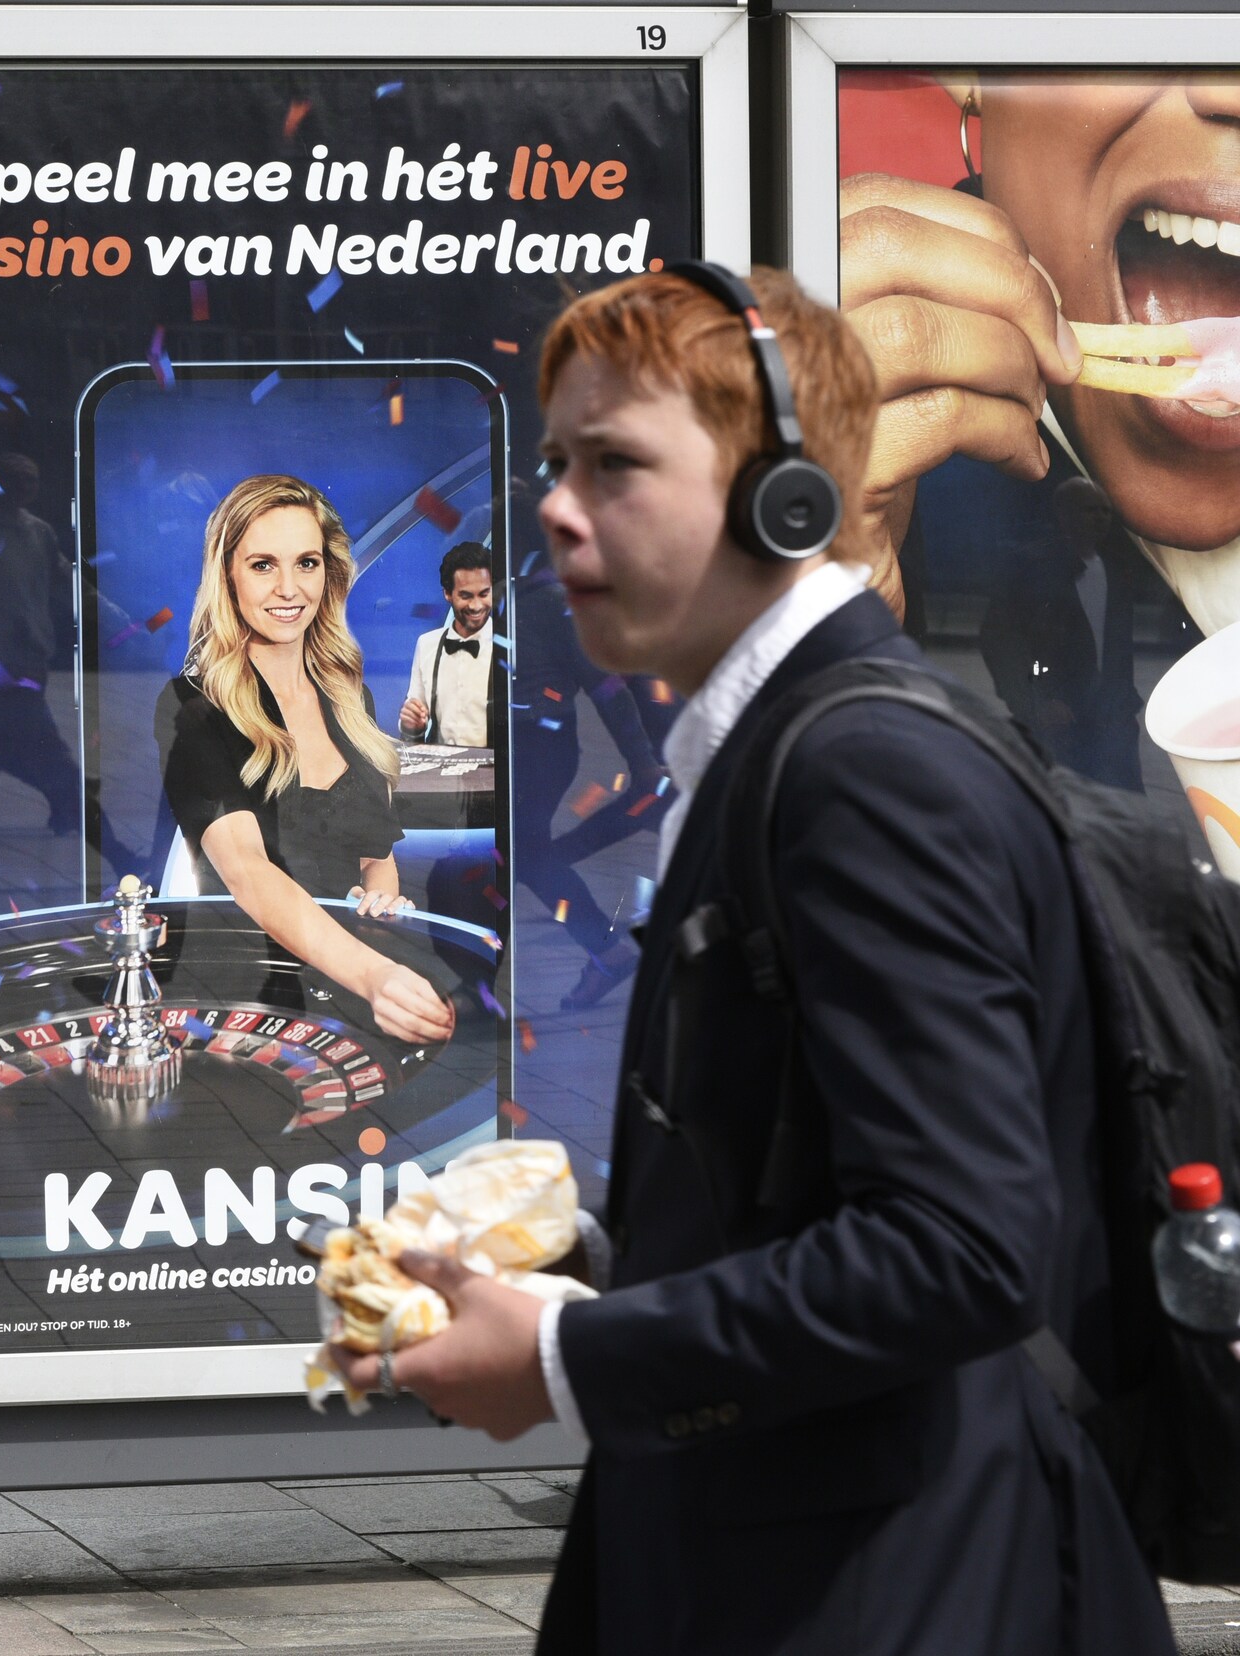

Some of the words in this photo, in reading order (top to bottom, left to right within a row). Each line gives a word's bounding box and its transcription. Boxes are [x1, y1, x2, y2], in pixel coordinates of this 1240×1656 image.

[636, 25, 668, 51] 19
[146, 162, 292, 202] mee
[305, 144, 369, 201] in
[382, 142, 498, 202] hét
[508, 144, 628, 201] live
[144, 237, 273, 277] van
[284, 218, 664, 276] Nederland.
[24, 1028, 54, 1046] 21
[66, 1020, 82, 1038] 2
[165, 1010, 188, 1028] 34
[204, 1010, 219, 1027] 6
[227, 1012, 257, 1030] 27
[256, 1016, 286, 1035] 13
[283, 1022, 313, 1042] 36
[306, 1031, 335, 1051] 11
[46, 1262, 105, 1295] Hét
[108, 1262, 208, 1292] online
[211, 1259, 316, 1289] casino
[13, 1322, 38, 1332] JOU?
[40, 1322, 68, 1331] STOP
[70, 1321, 86, 1330] OP
[87, 1320, 110, 1329] TIJD.
[113, 1319, 131, 1328] 18+
